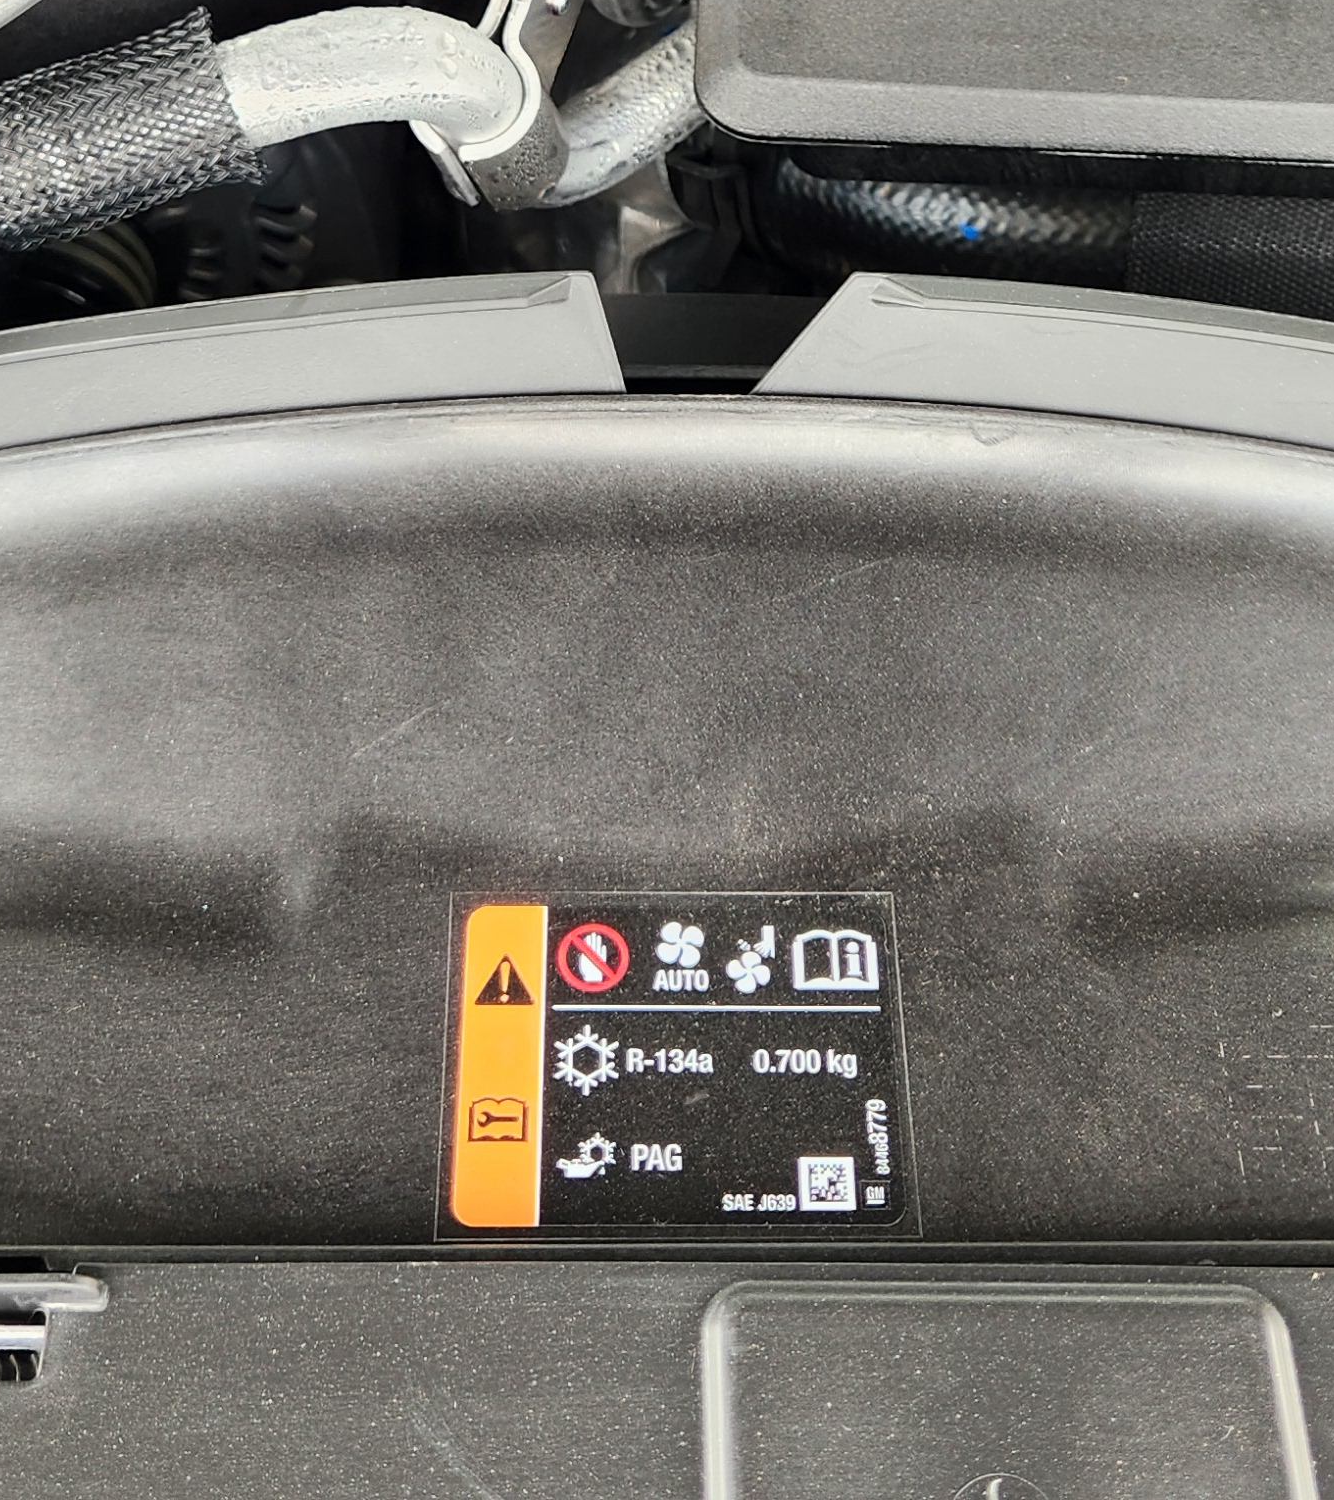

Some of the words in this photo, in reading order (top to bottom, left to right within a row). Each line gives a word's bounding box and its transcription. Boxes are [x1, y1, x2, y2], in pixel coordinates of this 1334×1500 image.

[652, 968, 710, 992] AUTO
[625, 1047, 714, 1074] R-134a
[752, 1048, 823, 1075] 0.700
[827, 1049, 859, 1079] kg
[866, 1098, 892, 1176] 84468779
[630, 1143, 684, 1172] PAG
[722, 1193, 755, 1212] SAE
[758, 1193, 797, 1212] J639
[865, 1185, 887, 1205] GM
